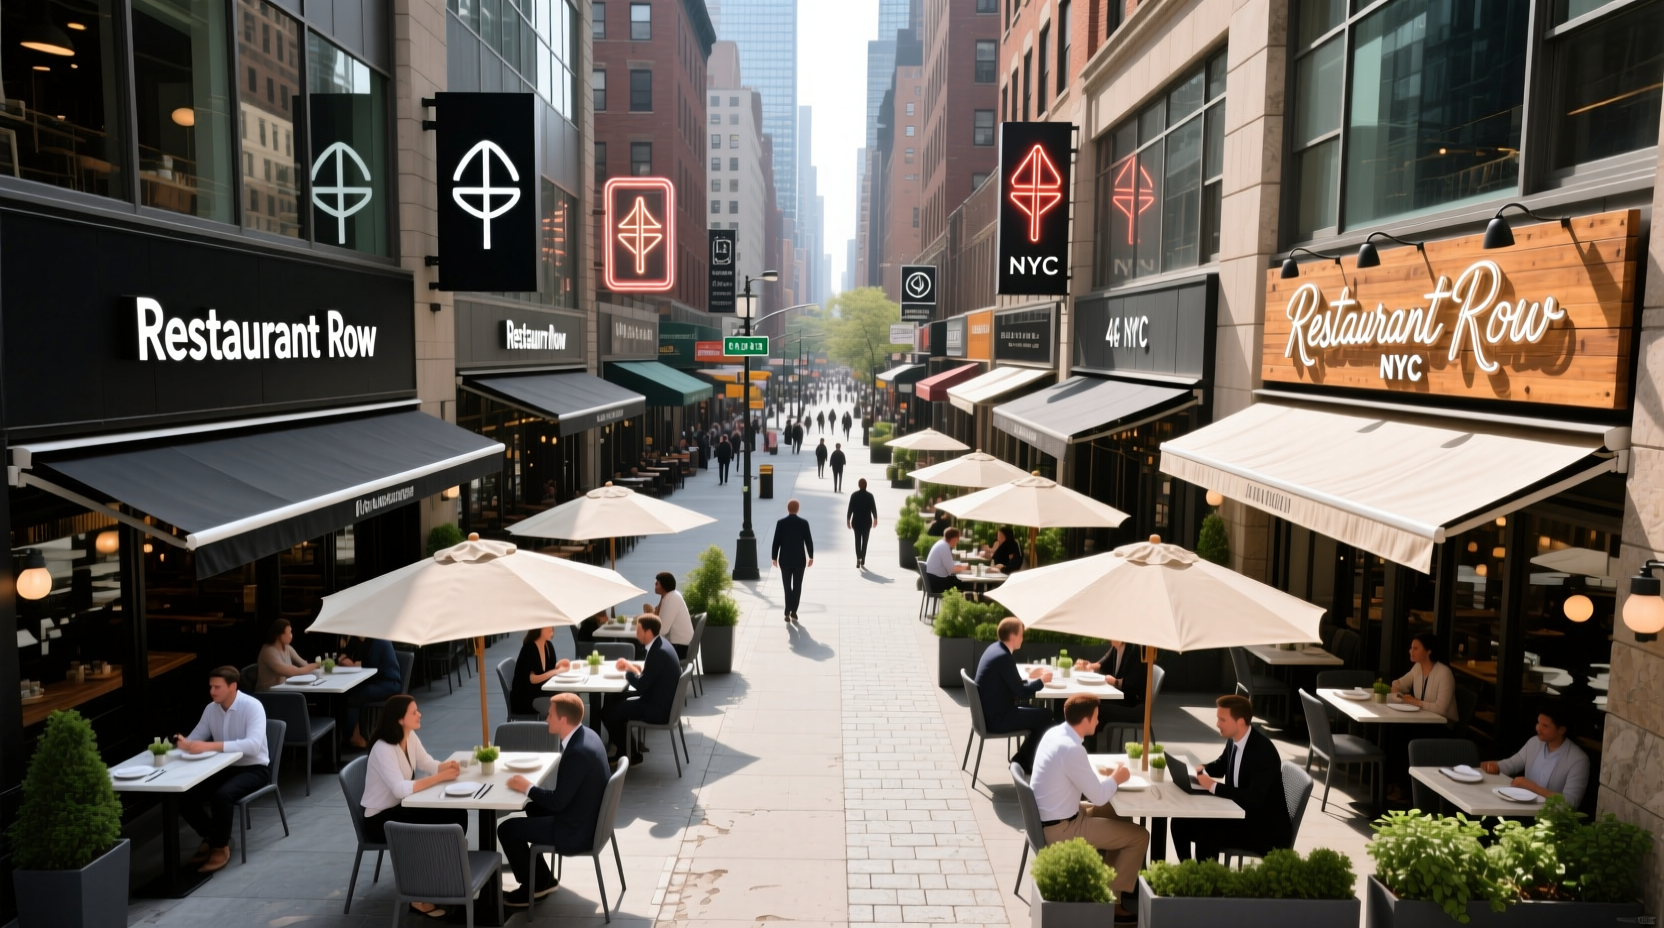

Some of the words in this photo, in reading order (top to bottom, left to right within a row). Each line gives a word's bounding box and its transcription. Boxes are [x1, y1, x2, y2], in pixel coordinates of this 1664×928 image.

[1009, 256, 1059, 276] NYC
[136, 296, 321, 362] Restaurant
[327, 309, 377, 358] Row
[1123, 315, 1149, 348] NYC
[1284, 275, 1452, 367] Restaurant
[1448, 259, 1566, 373] Row
[1379, 354, 1423, 382] NYC
